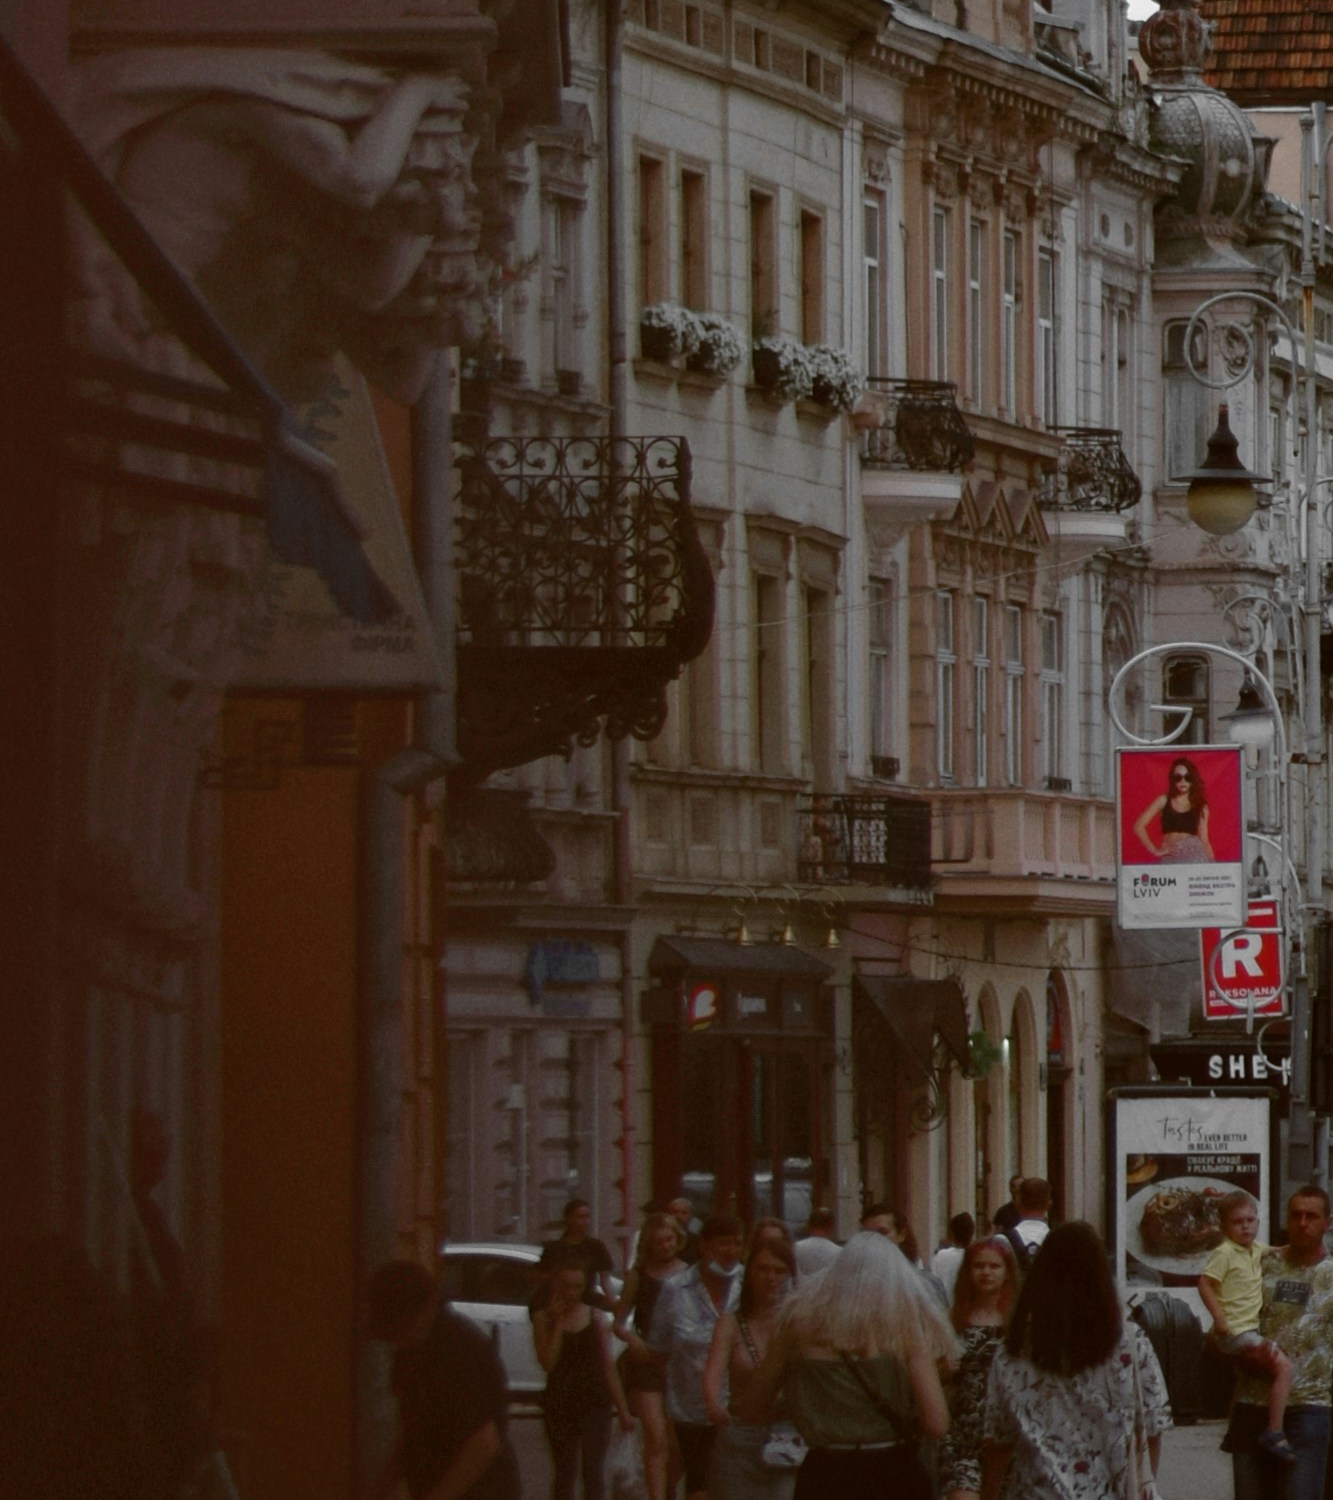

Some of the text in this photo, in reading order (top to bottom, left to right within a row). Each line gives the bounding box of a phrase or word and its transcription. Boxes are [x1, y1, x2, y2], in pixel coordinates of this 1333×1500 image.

[1134, 888, 1161, 898] LVIV
[1220, 928, 1264, 979] R
[1209, 986, 1276, 998] RKSOANA
[1214, 1142, 1229, 1150] LIFE
